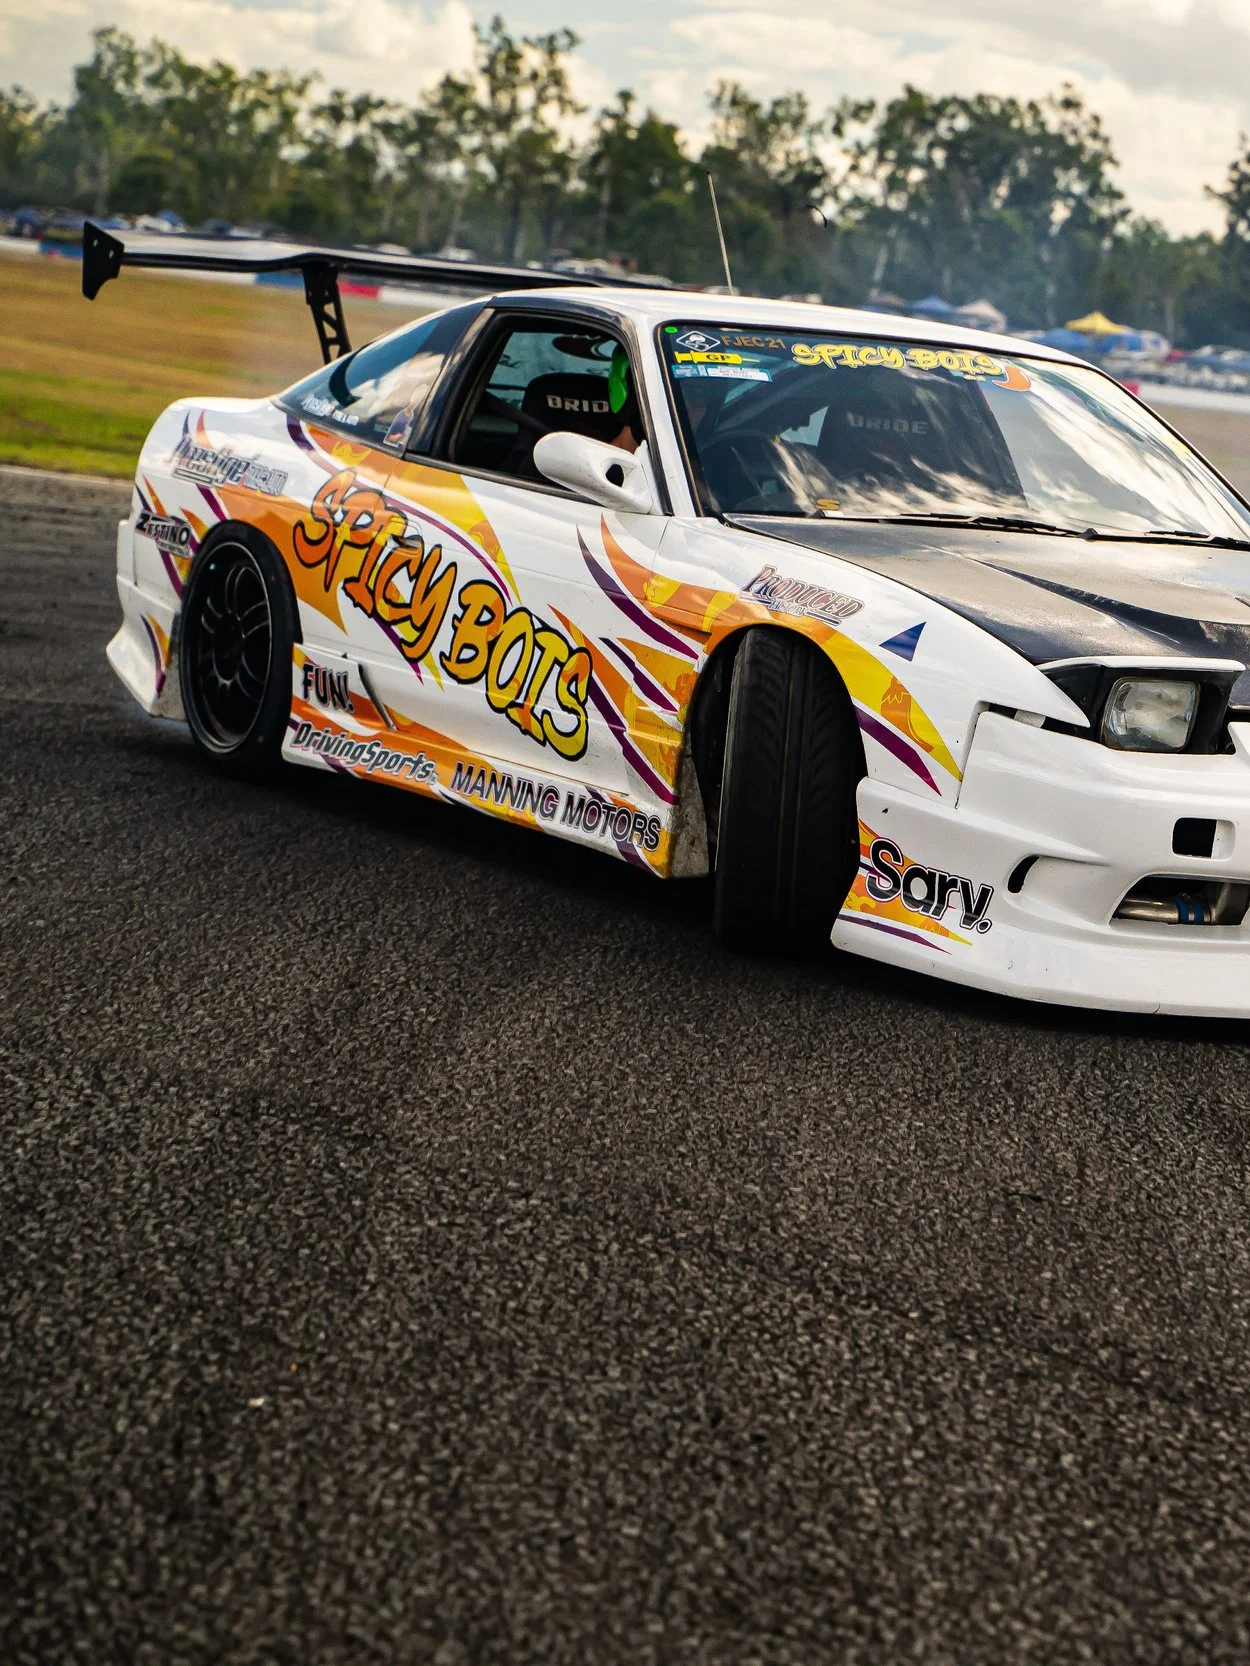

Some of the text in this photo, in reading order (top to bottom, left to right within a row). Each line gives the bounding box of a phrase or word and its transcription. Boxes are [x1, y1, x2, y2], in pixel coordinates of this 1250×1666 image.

[791, 343, 1003, 376] SPICY BOIS
[546, 394, 610, 413] BRID
[134, 511, 191, 548] ZESTINO
[293, 468, 592, 762] SPICY BOIS
[740, 564, 866, 620] PRODUCED
[302, 663, 355, 713] FUN!
[450, 761, 662, 850] MANNING MOTORS
